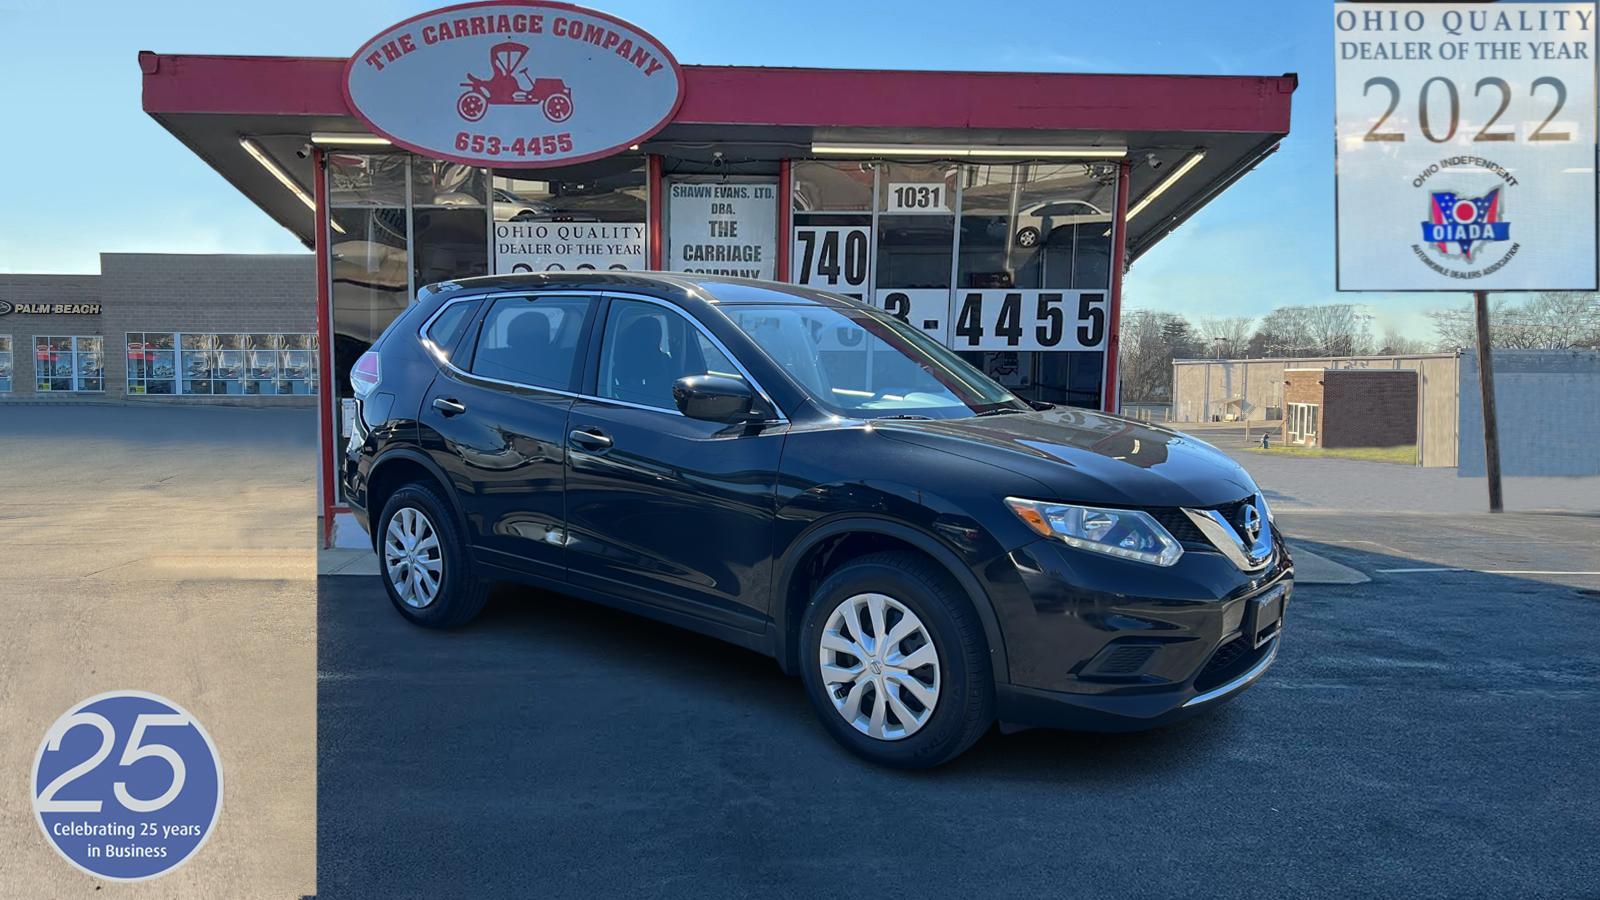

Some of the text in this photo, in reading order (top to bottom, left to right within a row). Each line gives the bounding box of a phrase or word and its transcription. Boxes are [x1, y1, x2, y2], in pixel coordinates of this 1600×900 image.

[1336, 10, 1593, 36] OHIO QUALITY
[365, 14, 665, 77] THE CARRIAGE COMPANY
[1340, 42, 1590, 60] DEALER OF THE YEAR
[1363, 76, 1571, 143] 2022
[455, 132, 573, 156] 653-4455
[1412, 155, 1519, 188] OHIO INDEPENDENT
[672, 185, 712, 198] SHAWN
[754, 187, 775, 200] LTD.
[894, 187, 941, 208] 1031
[711, 203, 736, 215] DBA.
[497, 226, 644, 240] OHIO QUALITY
[708, 220, 738, 238] THE
[1432, 224, 1495, 240] OIADA
[500, 243, 642, 255] DEALER OF THE YEAR
[682, 244, 762, 262] CARRIAGE
[797, 230, 868, 285] 740
[1449, 270, 1482, 279] DEALERS
[15, 304, 50, 313] PALM
